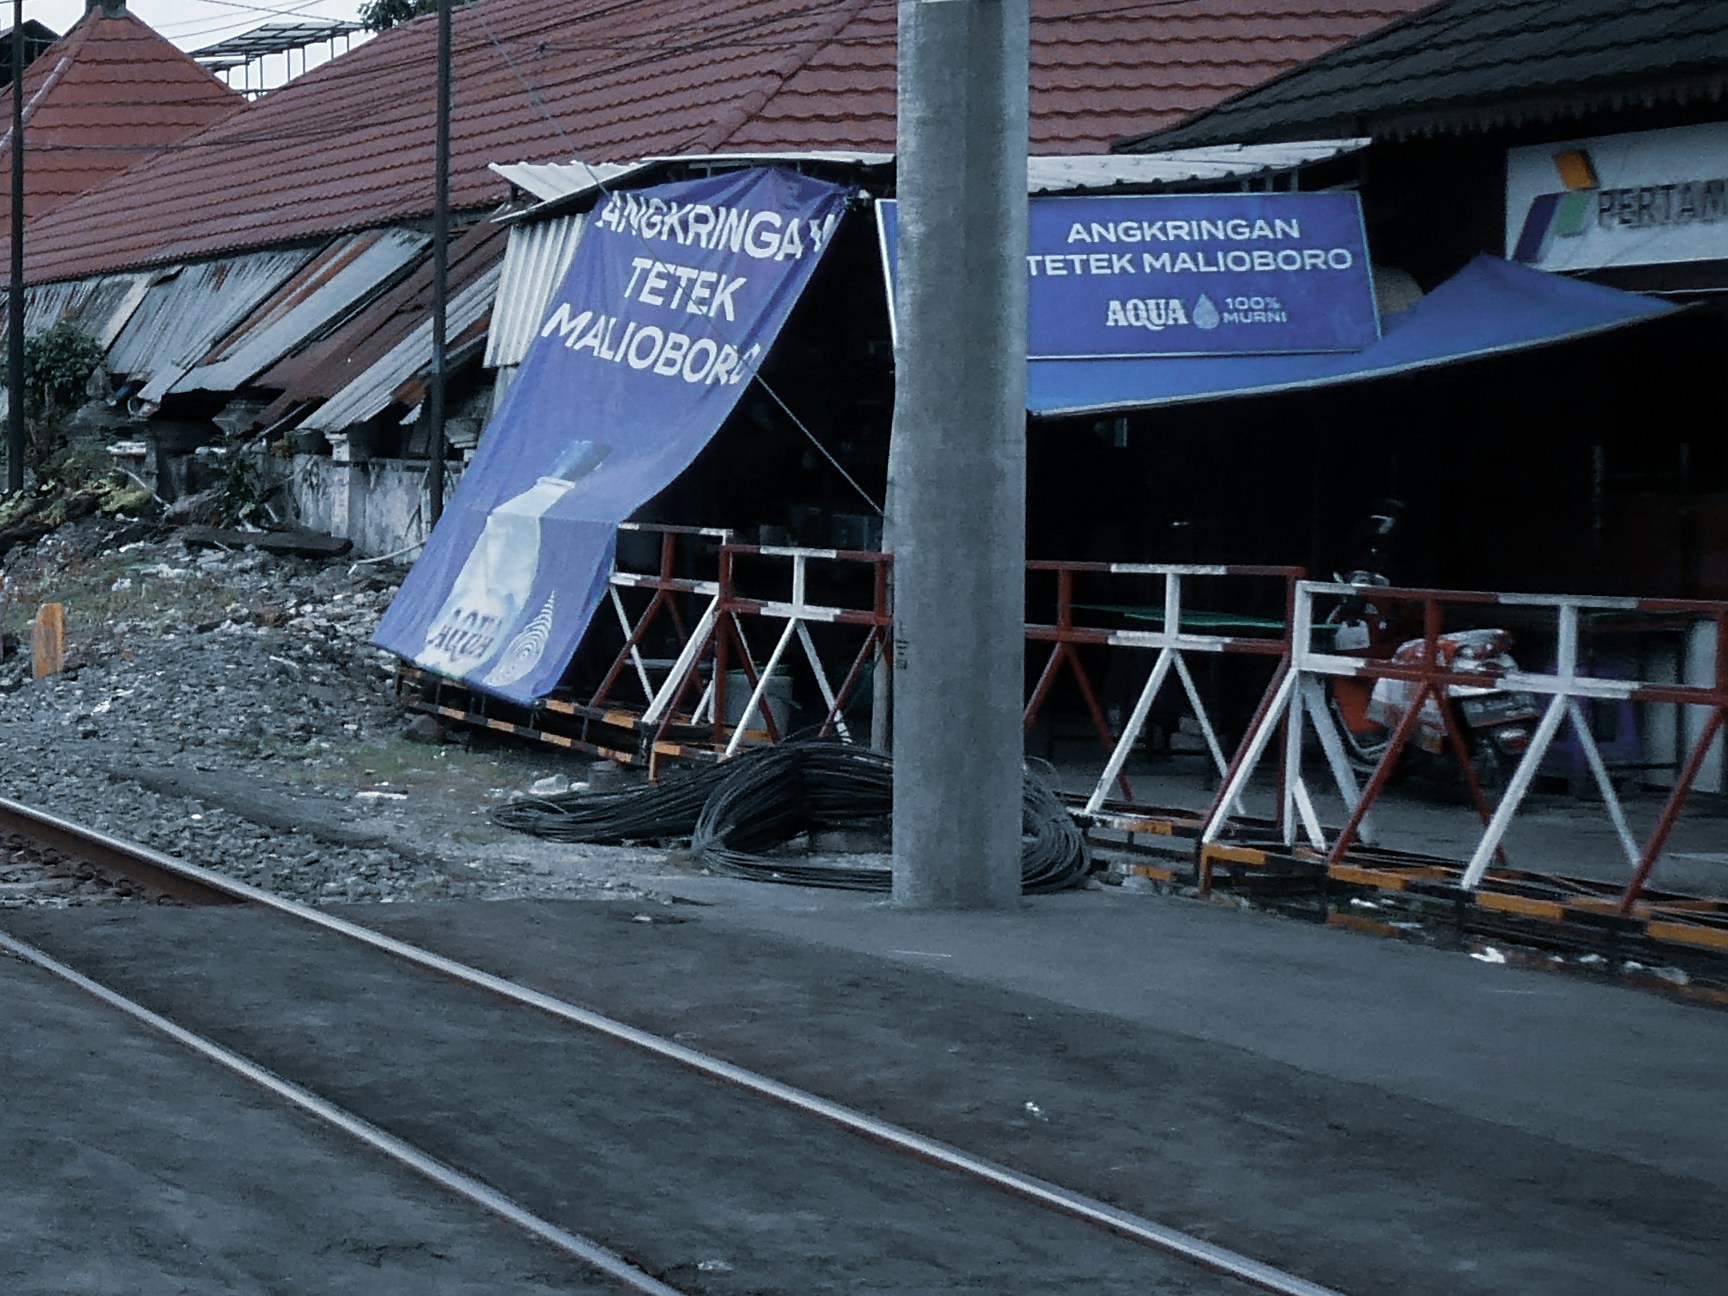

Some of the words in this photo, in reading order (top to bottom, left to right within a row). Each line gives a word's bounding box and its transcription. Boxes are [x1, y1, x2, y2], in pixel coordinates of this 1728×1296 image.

[1066, 218, 1301, 244] ANGKRINGAN
[1026, 254, 1136, 277] TETEK
[1143, 248, 1353, 274] MALIOBORO
[623, 257, 747, 322] TETEK
[1105, 298, 1189, 332] AQUA
[1225, 296, 1282, 311] 100%
[1222, 311, 1288, 325] MURNI
